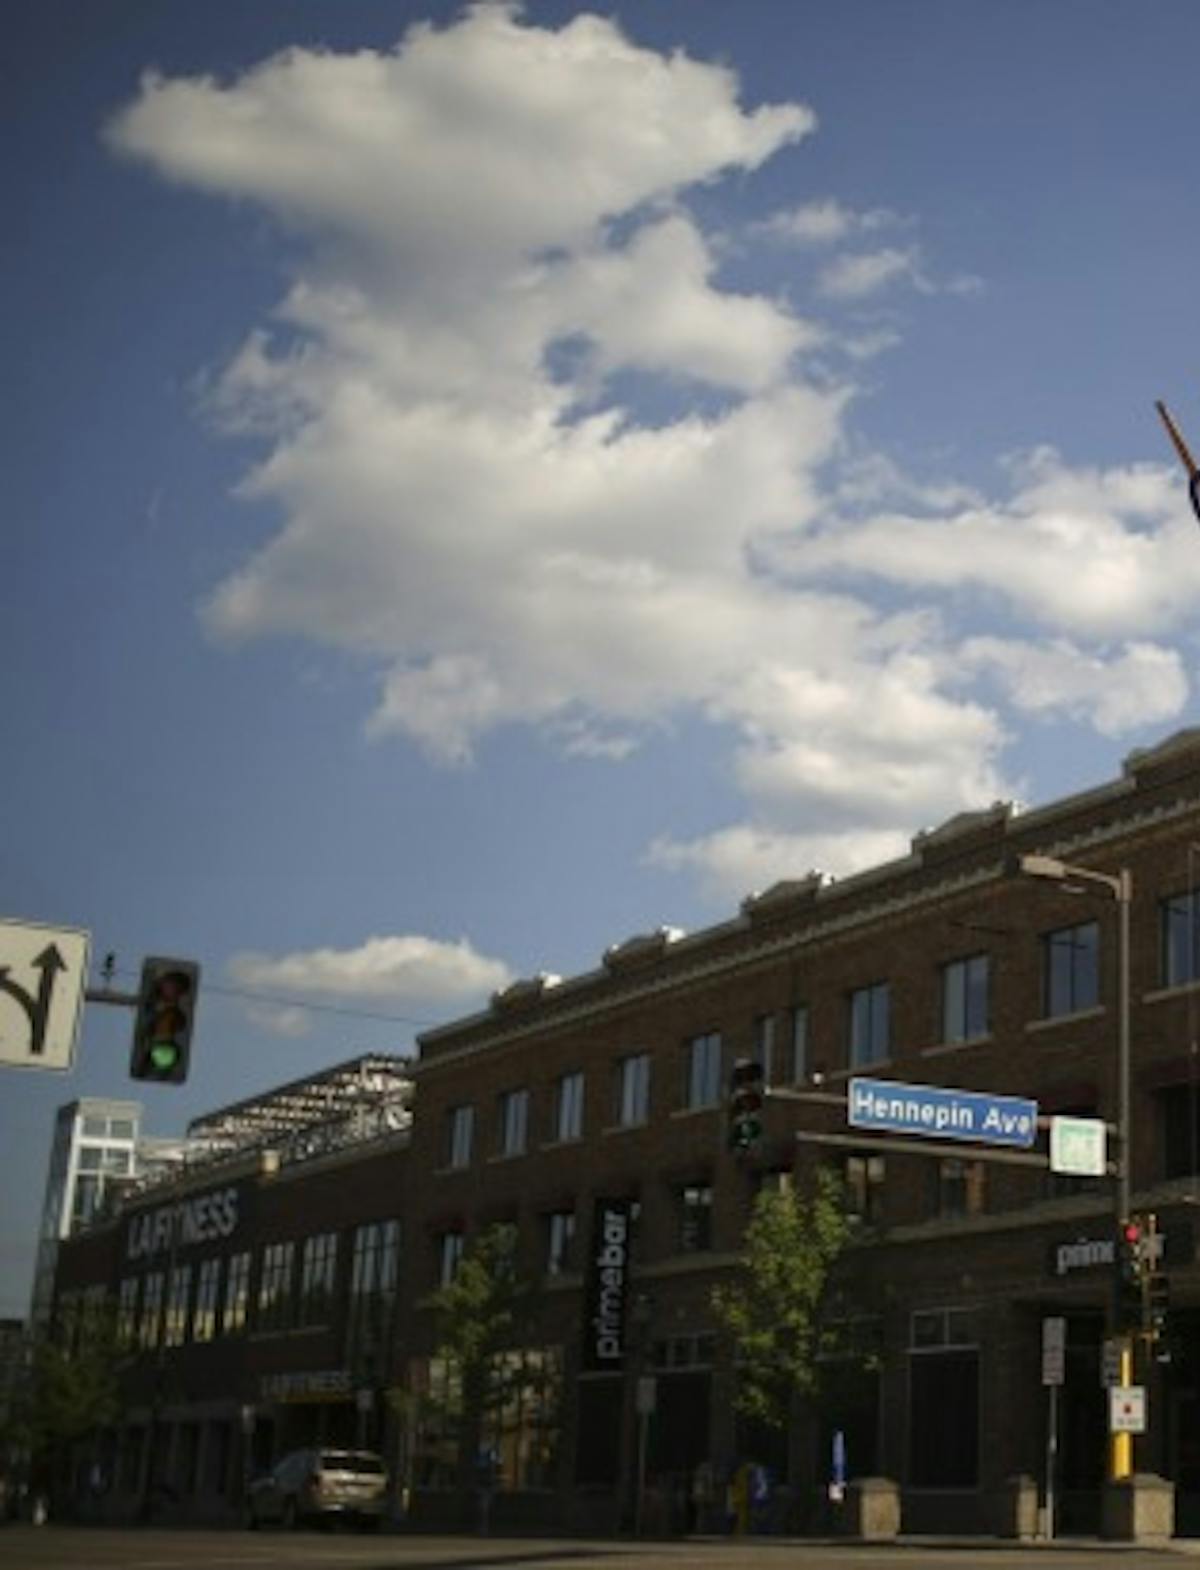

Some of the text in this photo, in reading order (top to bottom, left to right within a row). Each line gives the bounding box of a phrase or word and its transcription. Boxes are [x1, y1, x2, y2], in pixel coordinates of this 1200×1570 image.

[854, 1087, 1032, 1135] Hennepin Ave
[592, 1208, 627, 1360] primebar
